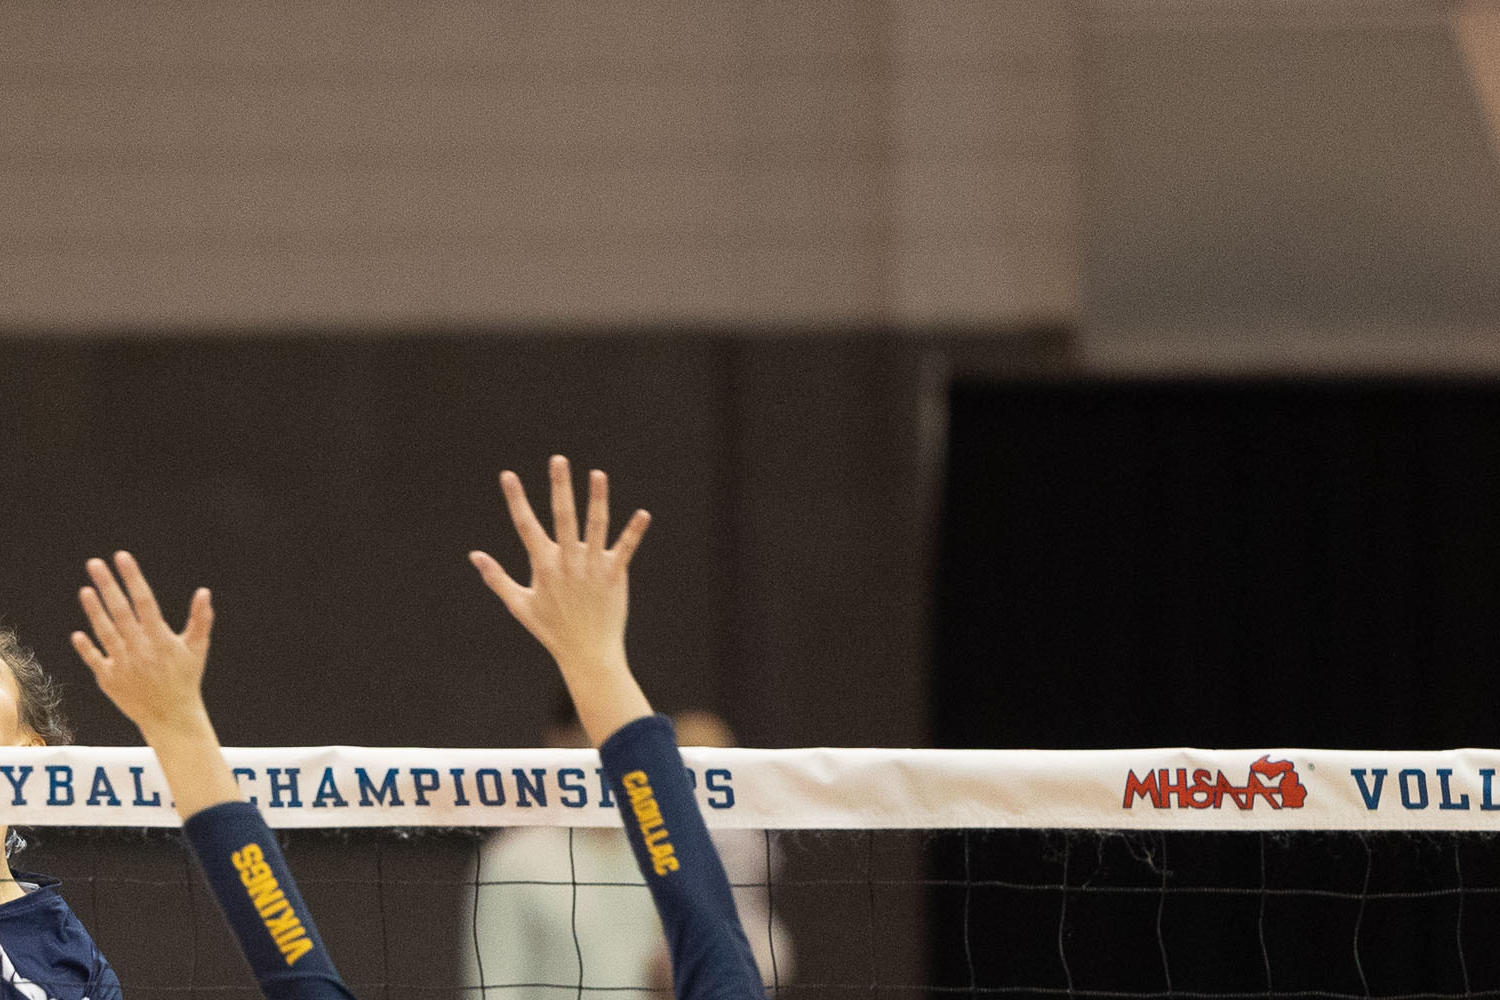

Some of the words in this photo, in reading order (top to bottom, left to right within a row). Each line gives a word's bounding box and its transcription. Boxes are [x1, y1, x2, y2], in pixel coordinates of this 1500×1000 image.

[232, 766, 735, 809] HAMPIONSS
[1122, 760, 1288, 810] MHSAA
[1350, 768, 1500, 811] VOLL
[230, 843, 314, 966] VIKINGS
